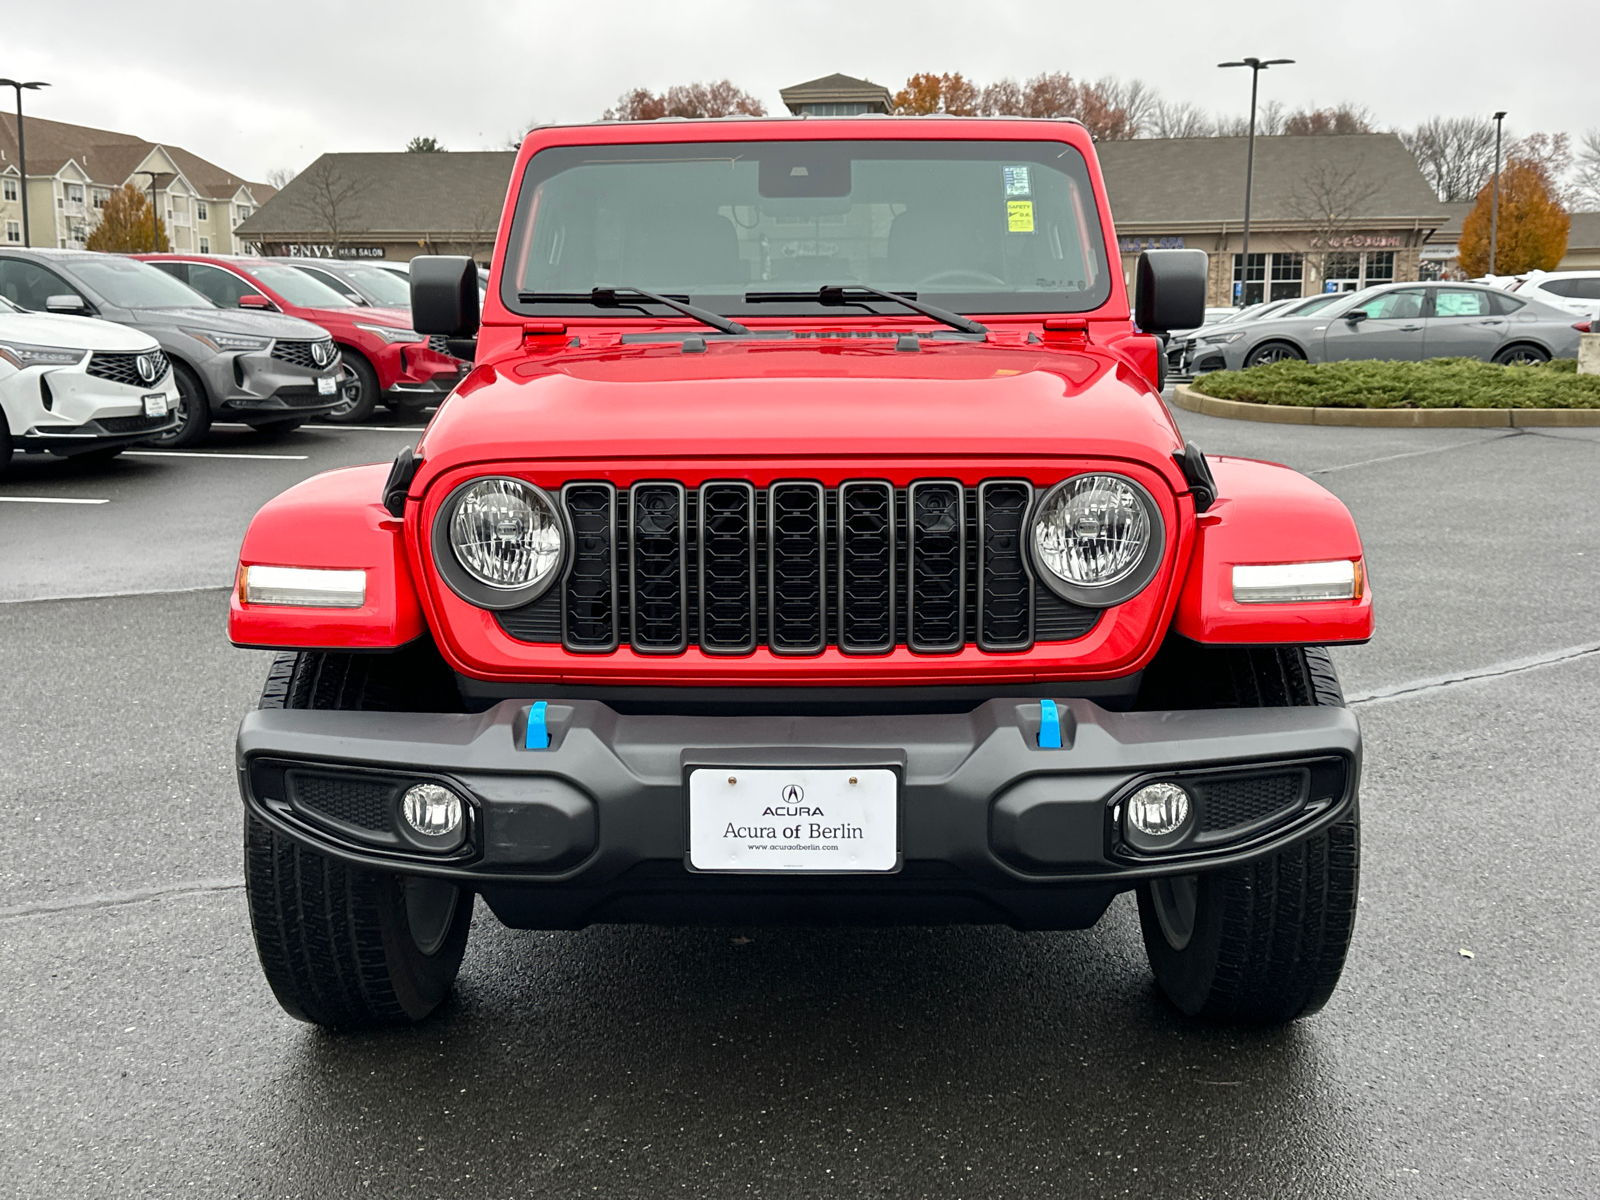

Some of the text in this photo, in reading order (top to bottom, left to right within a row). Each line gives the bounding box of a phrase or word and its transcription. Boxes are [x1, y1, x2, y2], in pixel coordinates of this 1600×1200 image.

[1160, 237, 1184, 249] SPA
[289, 245, 334, 257] ENVY
[358, 248, 383, 256] SALON
[762, 807, 824, 816] ACURA
[723, 822, 863, 839] Acura of Berlin
[748, 843, 838, 851] www.acuraofberlin.com
